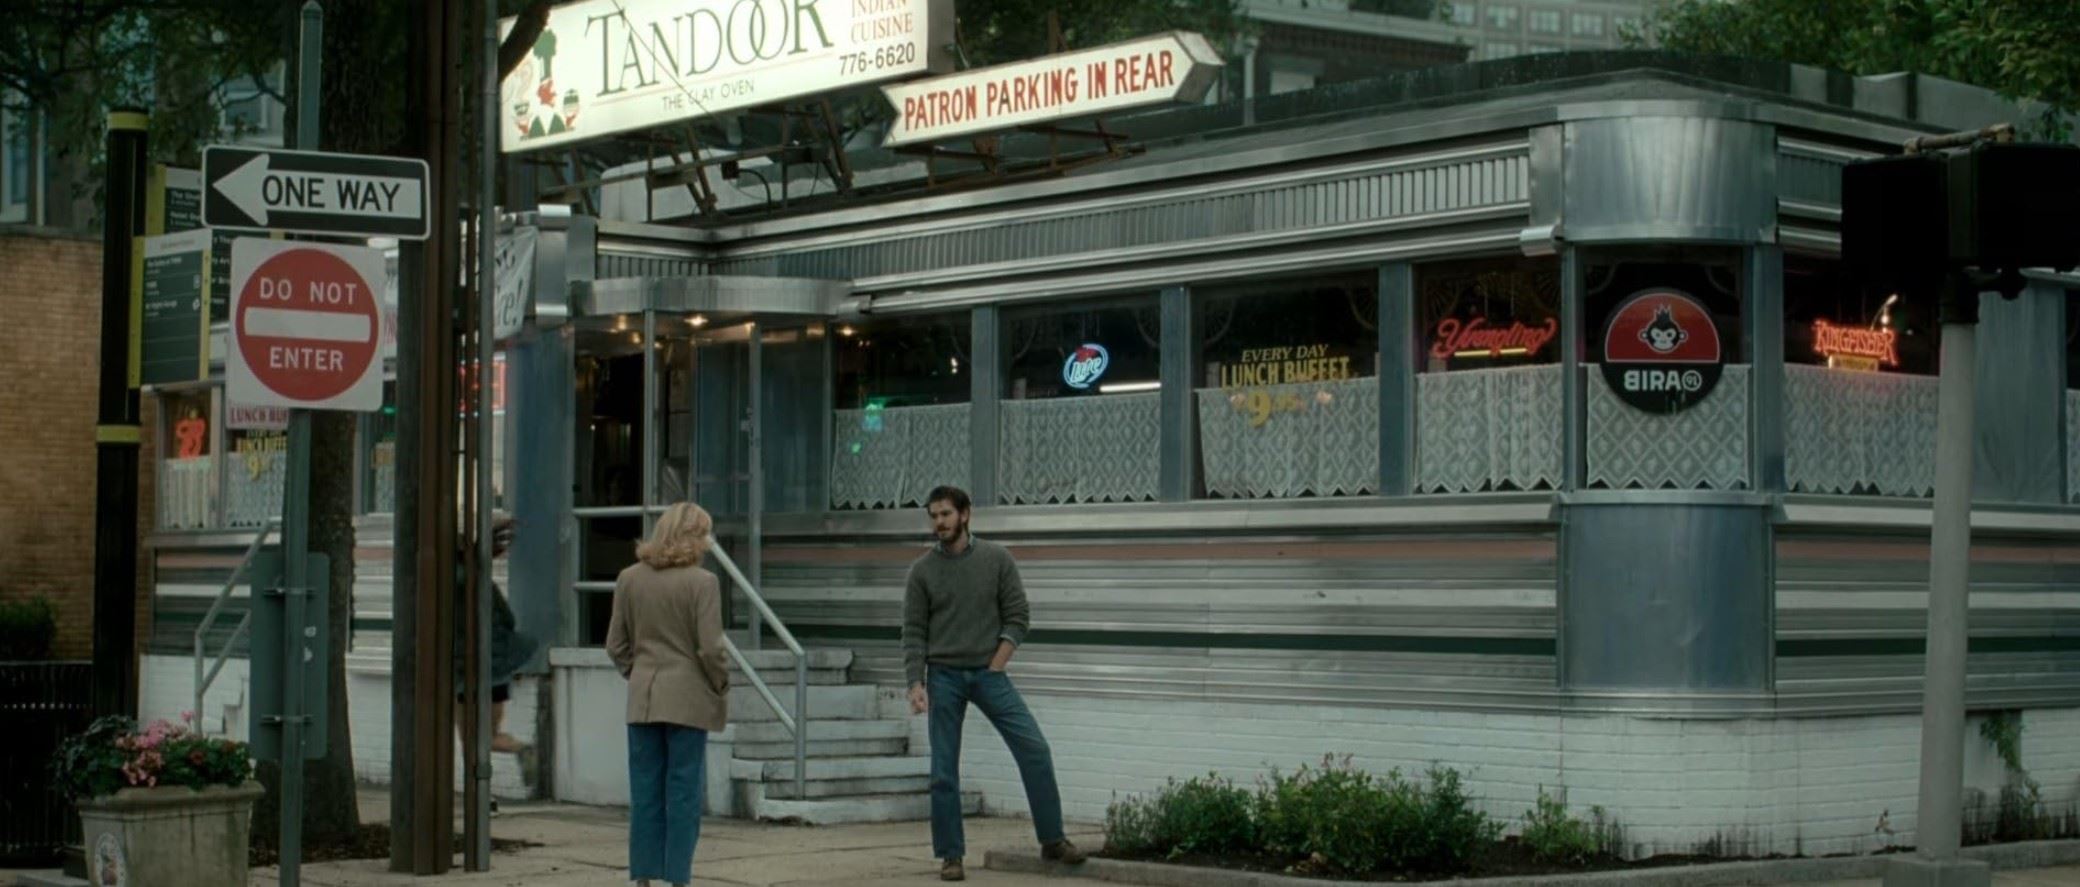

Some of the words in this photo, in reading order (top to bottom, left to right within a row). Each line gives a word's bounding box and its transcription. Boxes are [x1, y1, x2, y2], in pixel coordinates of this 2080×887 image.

[851, 12, 913, 44] CUISINE
[585, 0, 834, 97] TANDOOR
[839, 42, 915, 76] 776-6620
[663, 96, 683, 111] THE
[688, 88, 715, 105] CLAY
[720, 80, 755, 99] OVEN
[904, 85, 977, 131] PATRON
[986, 66, 1078, 118] PARKING
[1087, 61, 1107, 100] IN
[1114, 50, 1174, 95] REAR
[262, 175, 325, 208] ONE
[337, 179, 401, 212] WAY
[260, 277, 292, 300] DO
[310, 281, 357, 305] NOT
[269, 346, 344, 371] ENTER
[1242, 346, 1293, 362] EVERY
[1296, 344, 1328, 358] DAY
[1221, 361, 1279, 388] LUNCH
[1284, 356, 1349, 384] BUFFET
[1624, 370, 1682, 391] BIRA
